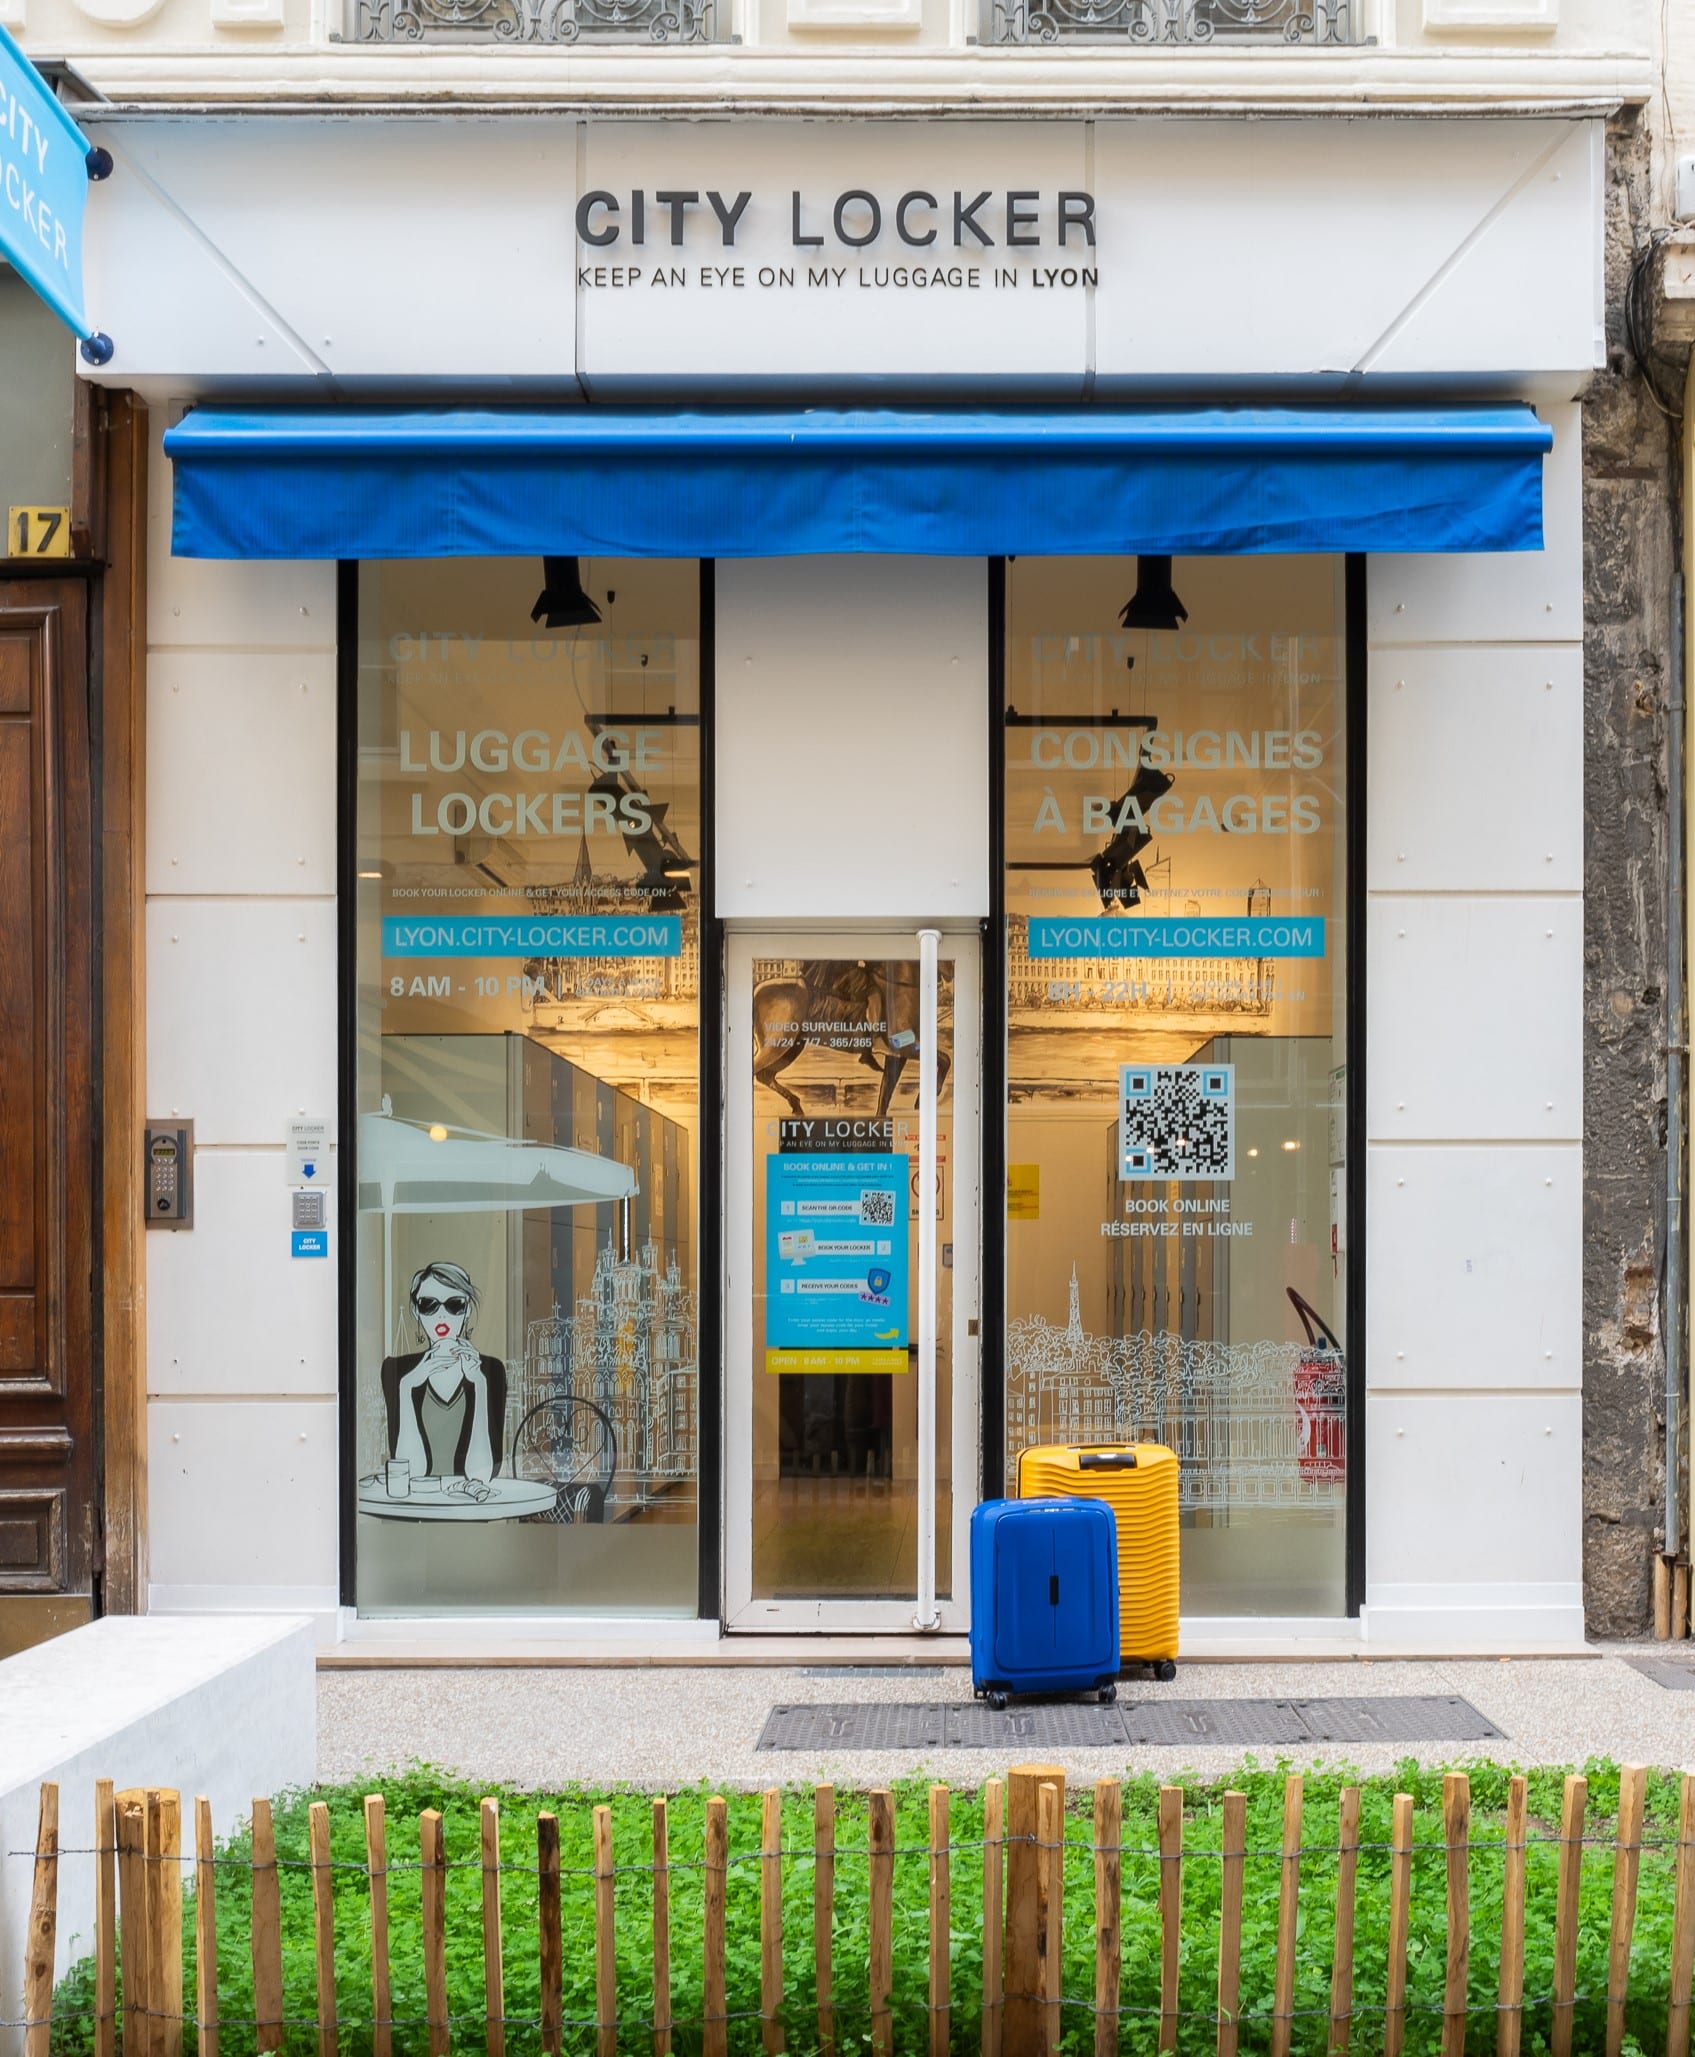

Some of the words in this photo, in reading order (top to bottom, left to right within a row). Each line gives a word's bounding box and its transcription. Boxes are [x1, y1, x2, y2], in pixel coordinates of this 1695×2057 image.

[0, 162, 69, 269] CKER
[575, 189, 753, 247] CITY
[791, 189, 1097, 247] LOCKER
[577, 266, 642, 288] KEEP
[650, 267, 686, 288] AN
[699, 267, 746, 288] EYE
[757, 267, 795, 288] ON
[807, 267, 847, 288] MY
[858, 266, 981, 288] LUGGAGE
[994, 267, 1018, 288] IN
[1031, 267, 1099, 288] LYON
[16, 510, 62, 553] 17
[388, 631, 485, 664] CITY
[1031, 631, 1129, 664] CITY
[1151, 631, 1322, 664] LOCKER
[400, 730, 665, 773] LUGGAGE
[1030, 730, 1324, 770] CONSIGNES
[411, 792, 652, 836] LOCKERS
[1031, 787, 1066, 835] À
[1083, 795, 1321, 835] BAGAGES
[392, 888, 420, 898] BOOK
[421, 888, 448, 898] YOUR
[450, 888, 488, 898] LOCKER
[489, 888, 524, 898] ONLINE
[624, 888, 650, 898] CODE
[651, 888, 667, 898] ON
[394, 926, 669, 947] LYON.CITY-LOCKER.COM
[1041, 927, 1313, 948] LYON.CITY-LOCKER.COM
[390, 976, 404, 997] 8
[408, 976, 451, 997] AM
[474, 976, 499, 997] 10
[506, 975, 545, 997] PM
[1049, 980, 1080, 1001] 8H
[1102, 980, 1147, 1001] 22H
[764, 1022, 799, 1032] VIDEO
[801, 1022, 887, 1032] SURVEILLANCE
[803, 1037, 821, 1048] 7/7
[829, 1037, 872, 1048] 365/365
[766, 1120, 815, 1138] CITY
[824, 1120, 910, 1138] LOCKER
[783, 1162, 809, 1172] BOOK
[811, 1162, 845, 1172] ONLINE
[857, 1162, 874, 1172] GET
[1125, 1199, 1169, 1213] BOOK
[1173, 1199, 1231, 1213] ONLINE
[1100, 1220, 1179, 1236] RÉSERVEZ
[1182, 1222, 1204, 1236] EN
[1207, 1222, 1253, 1236] LIGNE
[771, 1356, 797, 1366] OPEN
